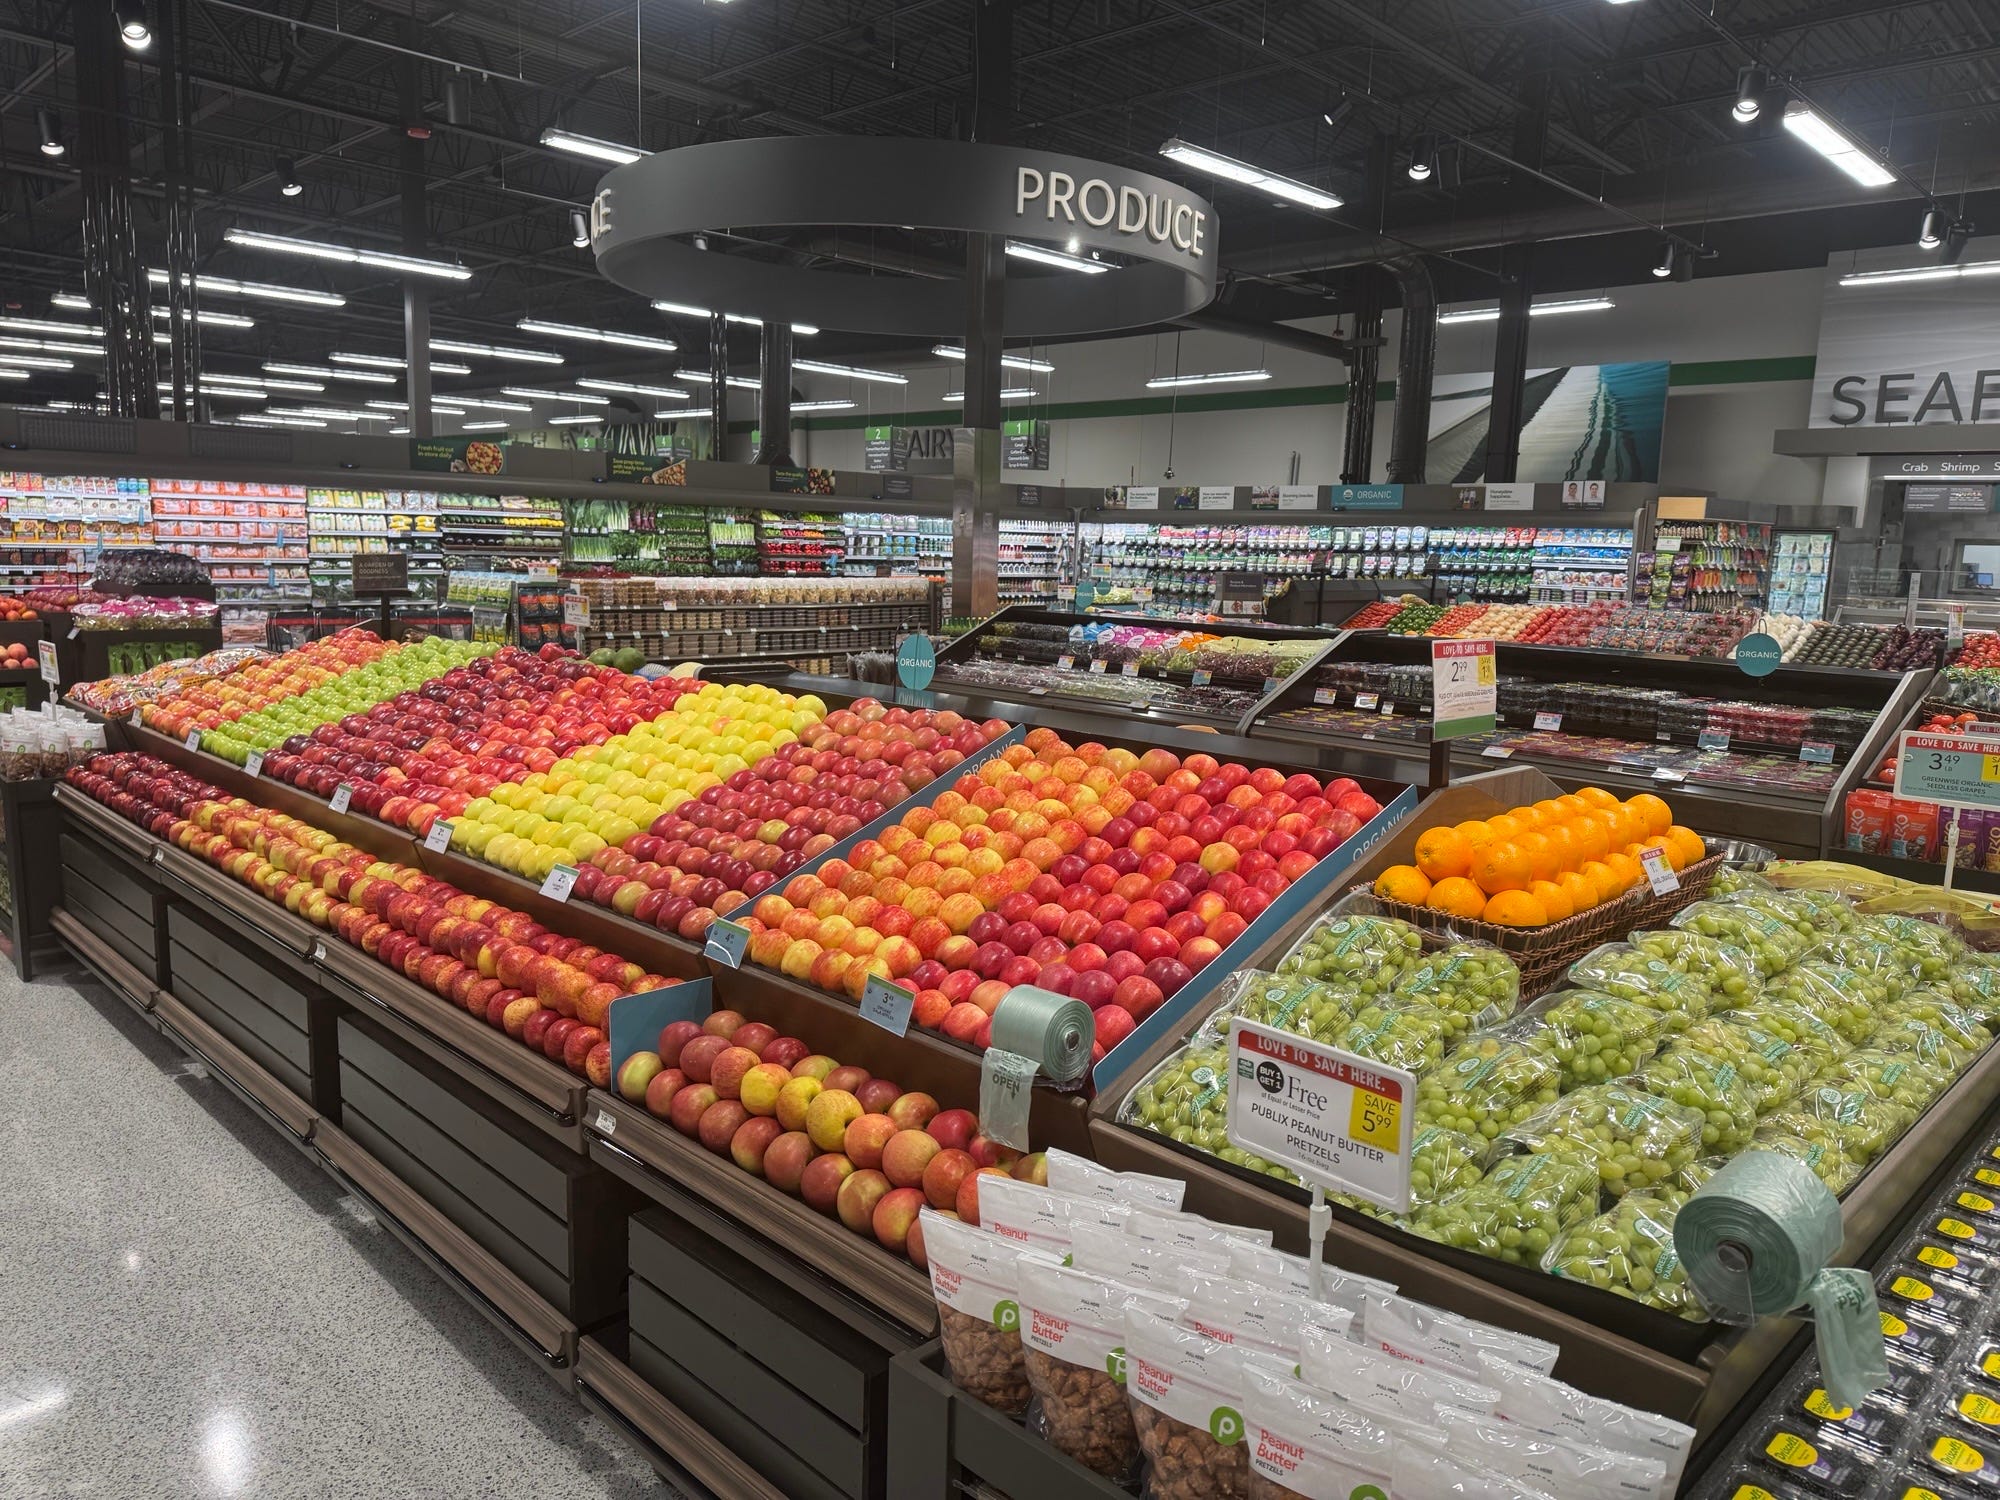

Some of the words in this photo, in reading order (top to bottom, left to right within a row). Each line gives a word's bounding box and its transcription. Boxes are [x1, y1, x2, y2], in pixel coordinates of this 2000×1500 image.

[1016, 166, 1206, 256] PRODUCE
[875, 428, 881, 440] 2
[1902, 462, 1929, 472] Crab
[1940, 462, 1981, 474] Shrimp
[1357, 489, 1392, 501] ORGANIC
[1443, 645, 1455, 655] LOVE
[1464, 644, 1475, 654] SAVE
[1738, 650, 1779, 659] ORGANIC
[900, 658, 933, 668] ORGANIC
[1917, 738, 1938, 747] LOVE
[1942, 740, 1953, 749] TO
[1958, 742, 1980, 752] SAVE
[1982, 744, 2000, 753] HER
[1921, 776, 1959, 785] GREENWISE
[1960, 780, 1993, 788] ORGANIC
[1926, 783, 1959, 792] SEEDLESS
[1959, 785, 1986, 794] GRAPES
[1257, 1036, 1287, 1057] LOVE
[1291, 1047, 1308, 1064] TO
[1314, 1057, 1344, 1077] SAVE
[1350, 1068, 1386, 1092] HERE.
[1260, 1066, 1275, 1077] BUY
[992, 1073, 1020, 1092] OPEN
[1259, 1076, 1274, 1087] GET
[1275, 1081, 1281, 1089] 1
[1287, 1075, 1328, 1111] Free
[1267, 1094, 1282, 1104] Equal
[1289, 1102, 1306, 1114] Lesser
[1306, 1110, 1320, 1120] Price
[1364, 1094, 1396, 1116] SAVE
[1251, 1102, 1289, 1126] PUBLIX
[1291, 1119, 1335, 1145] PEANUT
[1338, 1137, 1384, 1163] BUTTER
[1286, 1134, 1340, 1164] PRETZELS
[994, 1222, 1029, 1242] Peanut
[935, 1263, 962, 1284] Peanut
[935, 1273, 959, 1294] Butter
[1032, 1309, 1070, 1333] Peanut
[1030, 1334, 1053, 1349] PRETZELS
[1032, 1321, 1064, 1343] Butter
[1194, 1322, 1235, 1344] Peanut
[1138, 1360, 1174, 1386] Peanut
[1138, 1372, 1168, 1397] Butter
[1260, 1428, 1305, 1460] Peanut
[1774, 1436, 1799, 1460] Driscoll's
[1255, 1458, 1284, 1477] PRETZELS
[1256, 1443, 1298, 1472] Butter
